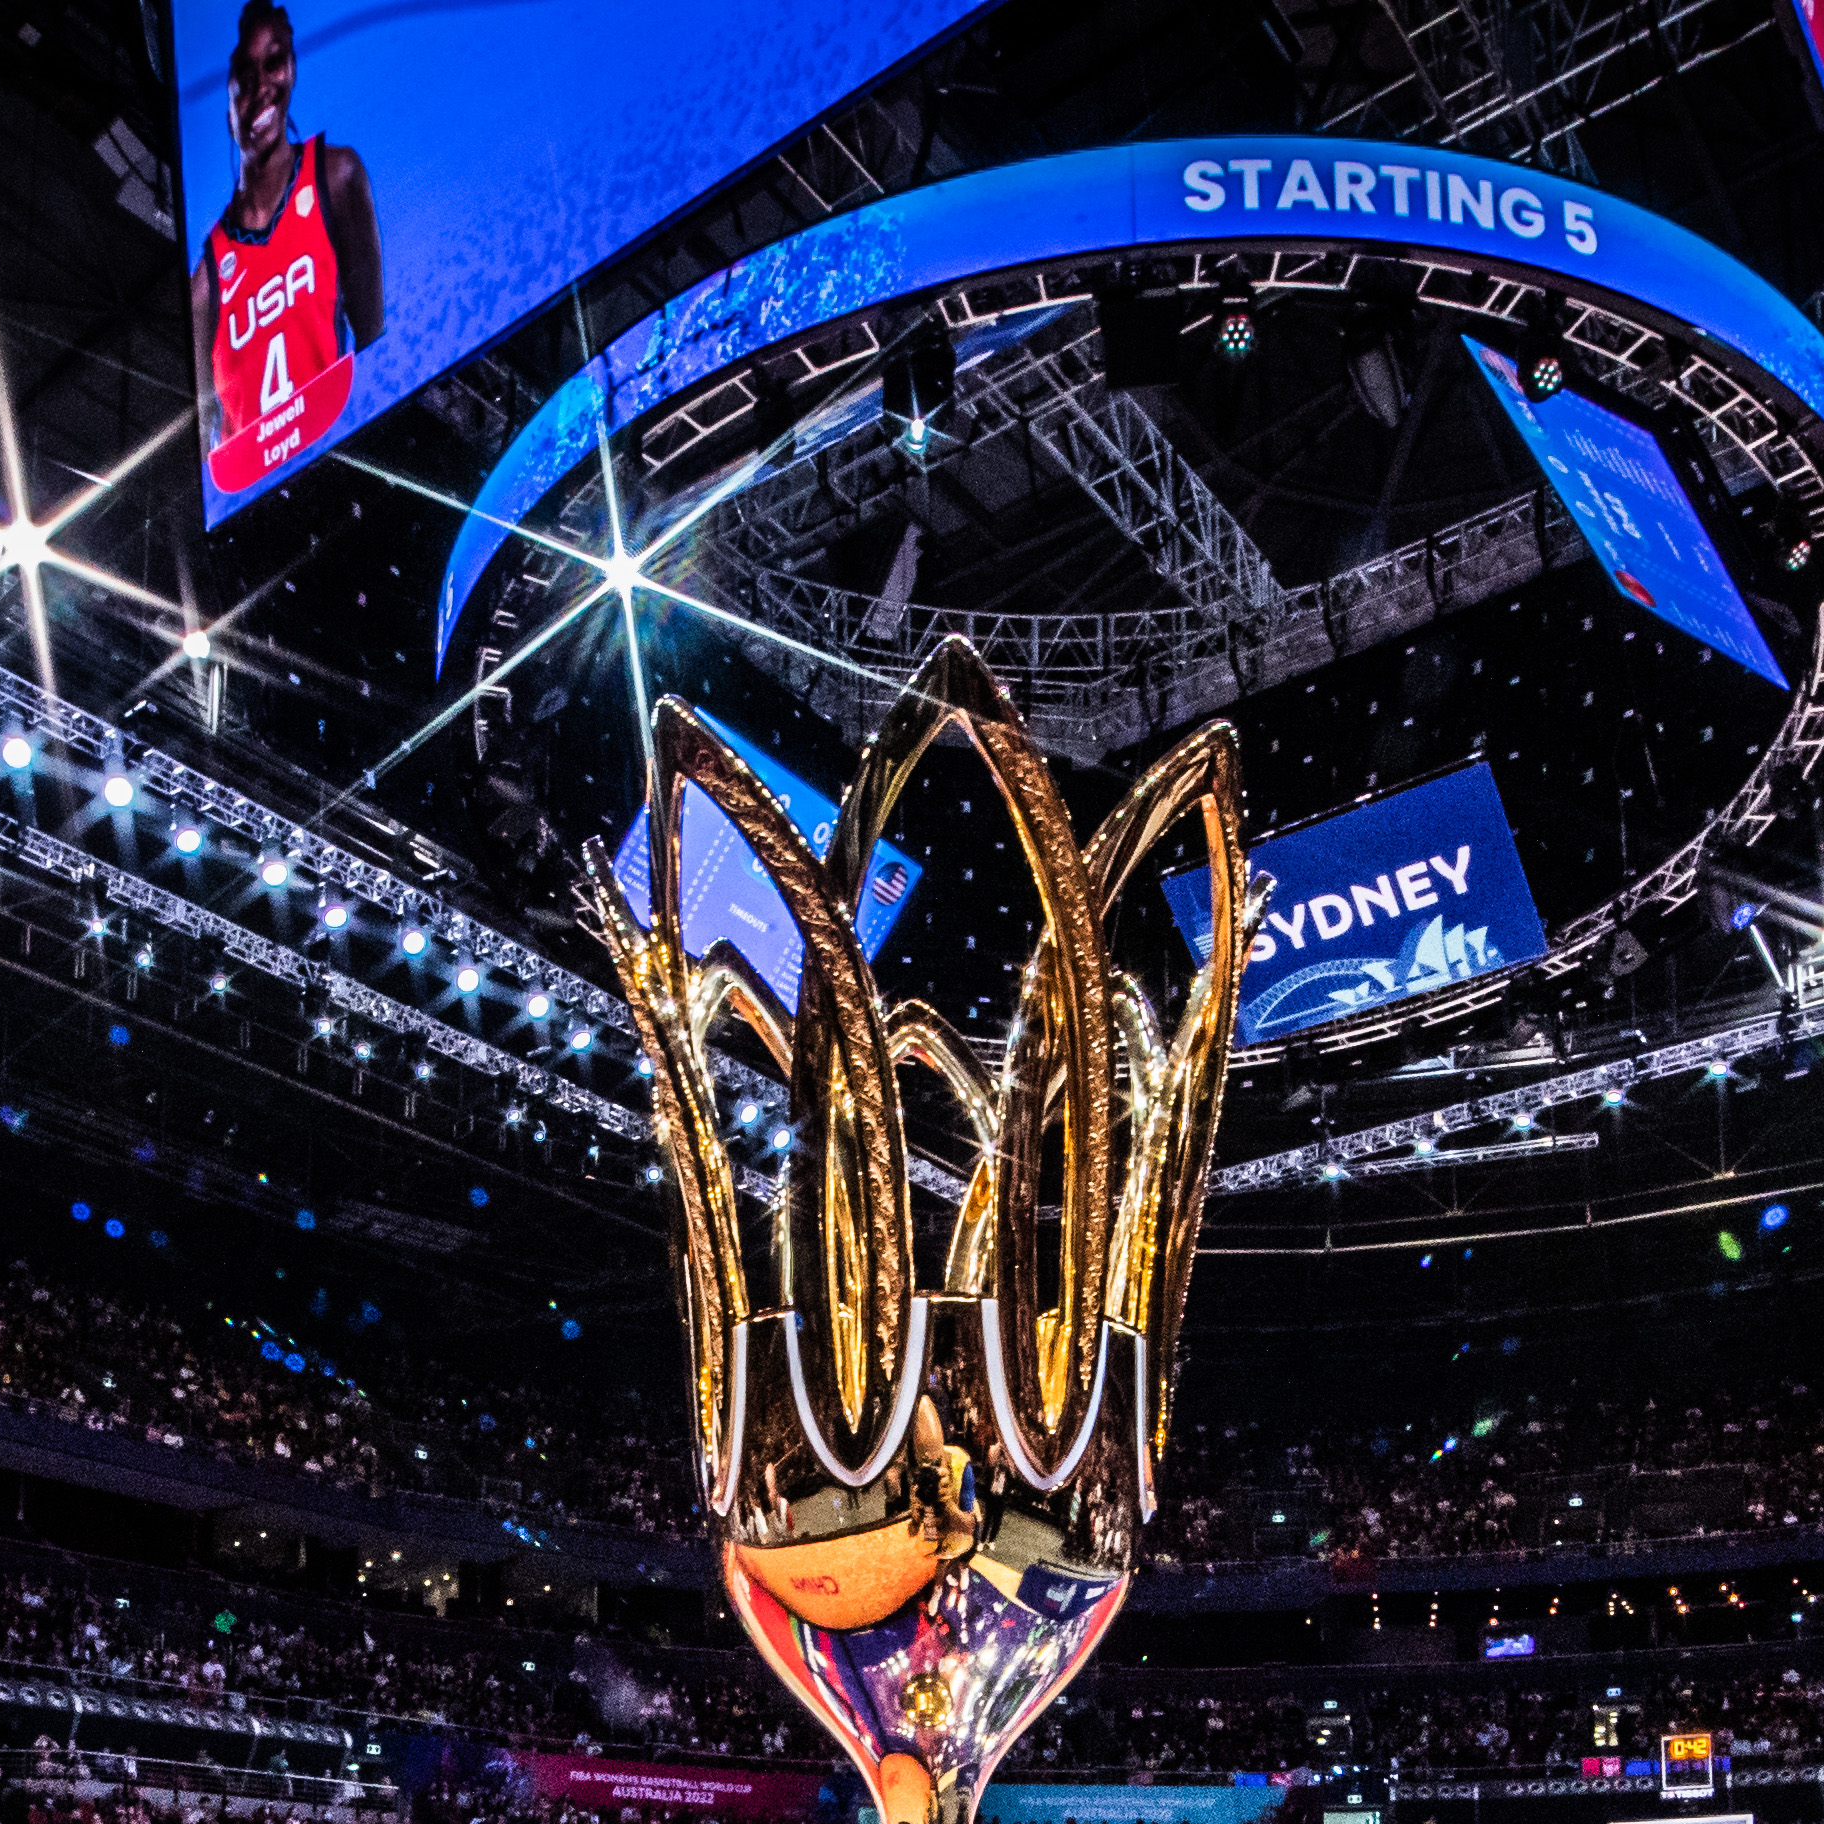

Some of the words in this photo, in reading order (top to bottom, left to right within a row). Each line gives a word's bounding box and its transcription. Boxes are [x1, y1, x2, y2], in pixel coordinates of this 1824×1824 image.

[1183, 157, 1546, 238] STARTING
[1564, 200, 1599, 256] 5
[228, 254, 315, 351] USA
[260, 332, 294, 416] 4
[256, 395, 305, 443] Jewell
[263, 428, 300, 467] Loyd
